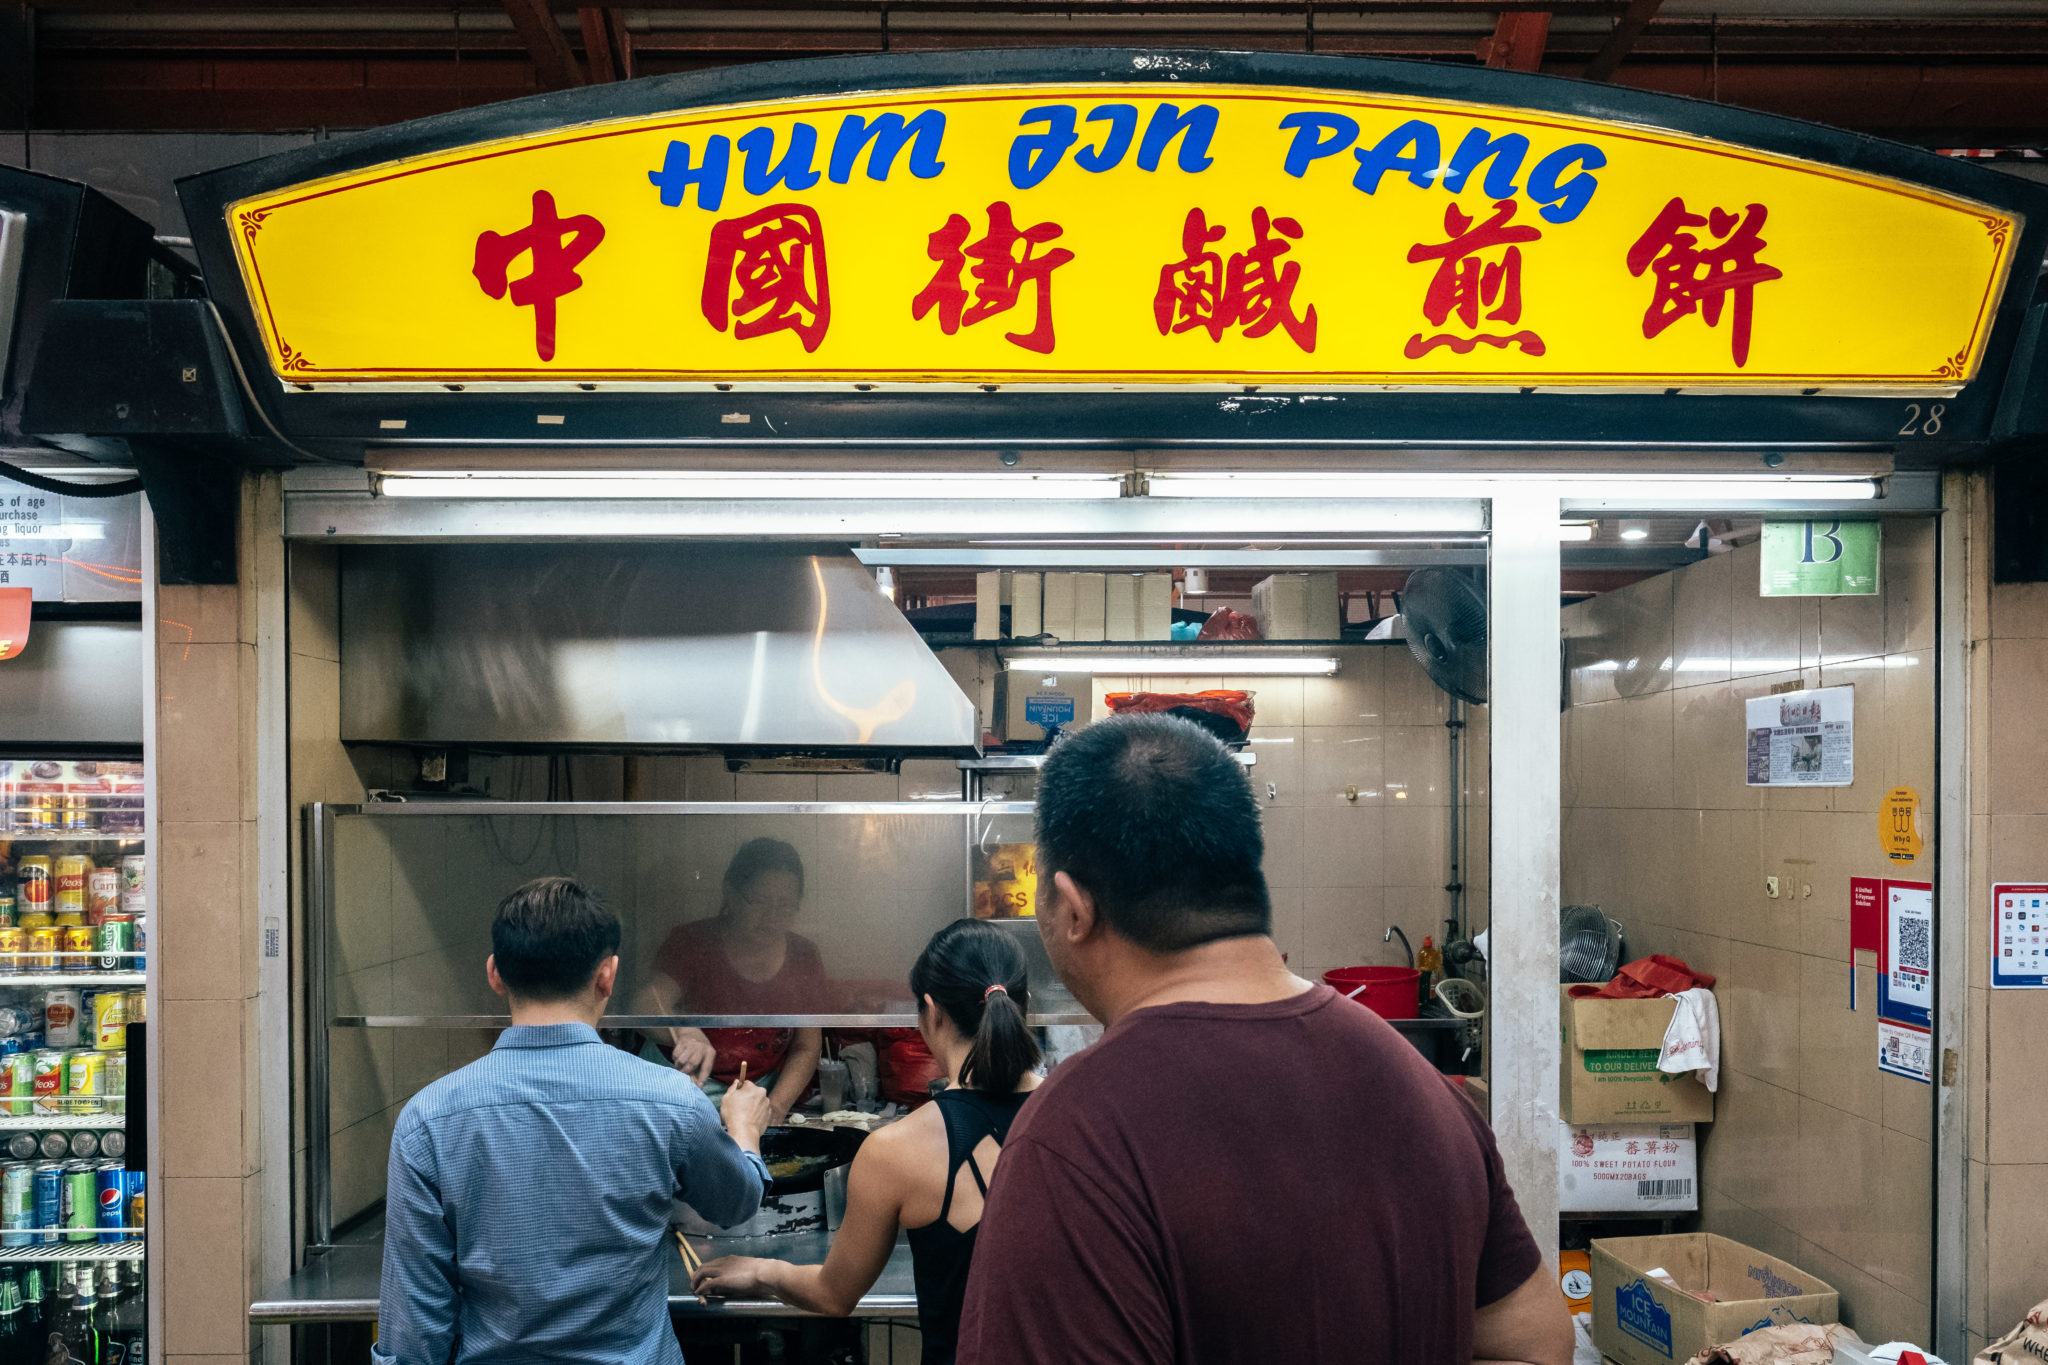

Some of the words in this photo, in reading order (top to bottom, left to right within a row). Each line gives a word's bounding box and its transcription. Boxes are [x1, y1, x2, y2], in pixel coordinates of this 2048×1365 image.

[1898, 403, 1946, 436] 28
[11, 496, 21, 507] of
[28, 498, 46, 510] age
[15, 522, 42, 536] liquor
[1800, 519, 1844, 564] B
[1029, 704, 1071, 713] MOUNTAIN
[1042, 713, 1059, 722] ICE
[1590, 1062, 1602, 1071] TO
[1604, 1062, 1622, 1071] OUR
[1572, 1160, 1590, 1168] 100%
[1594, 1160, 1618, 1168] SWEET
[1622, 1160, 1651, 1169] POTATO
[1653, 1160, 1676, 1168] FLOUR
[1631, 1293, 1652, 1317] ICE
[1619, 1303, 1668, 1341] MOUNTAIN
